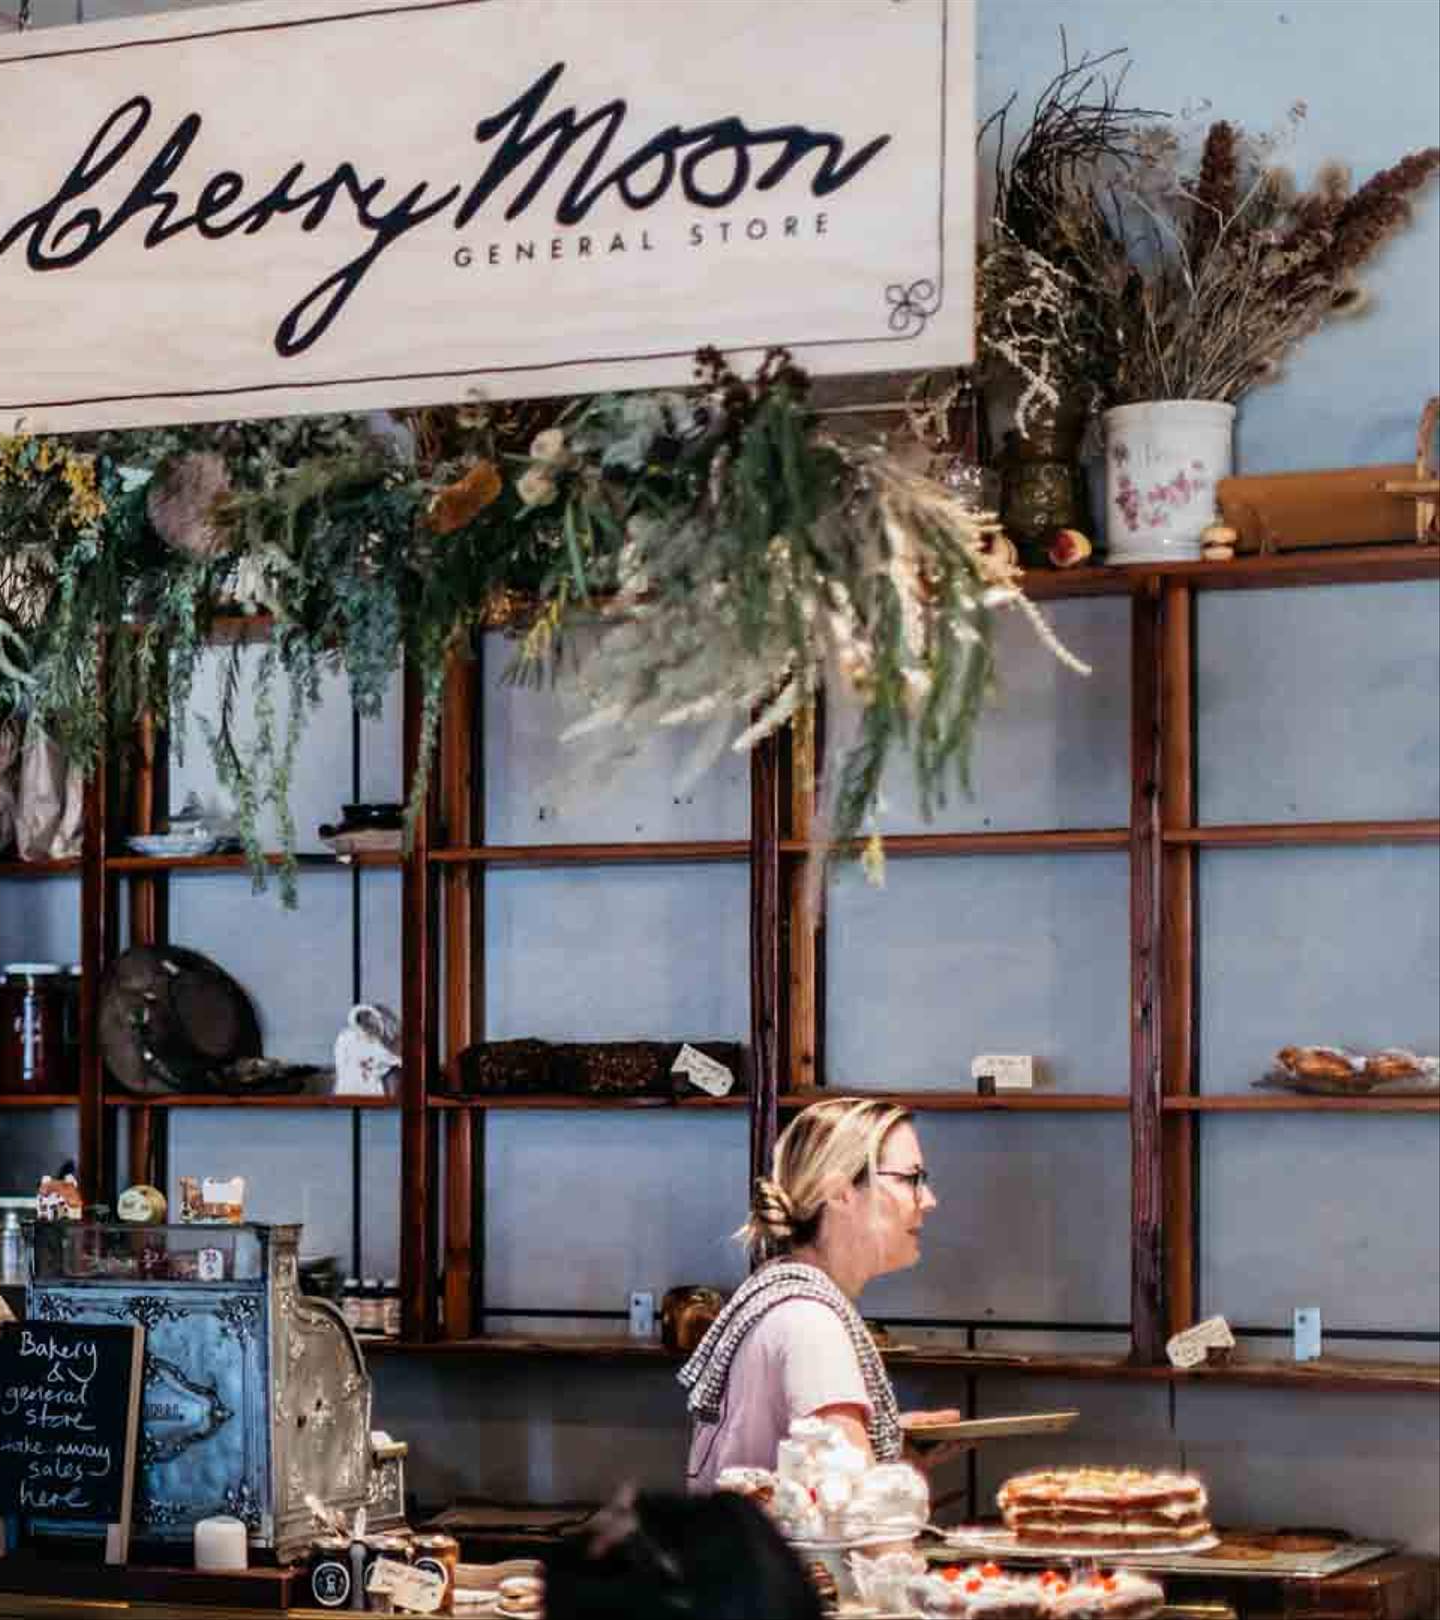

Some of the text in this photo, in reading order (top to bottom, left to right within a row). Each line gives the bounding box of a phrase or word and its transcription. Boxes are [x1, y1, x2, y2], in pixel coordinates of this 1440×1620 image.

[455, 63, 890, 229] Moon
[453, 212, 829, 268] GENERAL STORE
[19, 1331, 98, 1382] Bakery
[47, 1361, 66, 1382] &
[1, 1383, 89, 1415] general
[26, 1403, 96, 1431] store
[27, 1459, 85, 1483] sales
[56, 1443, 111, 1477] away
[20, 1479, 90, 1508] here
